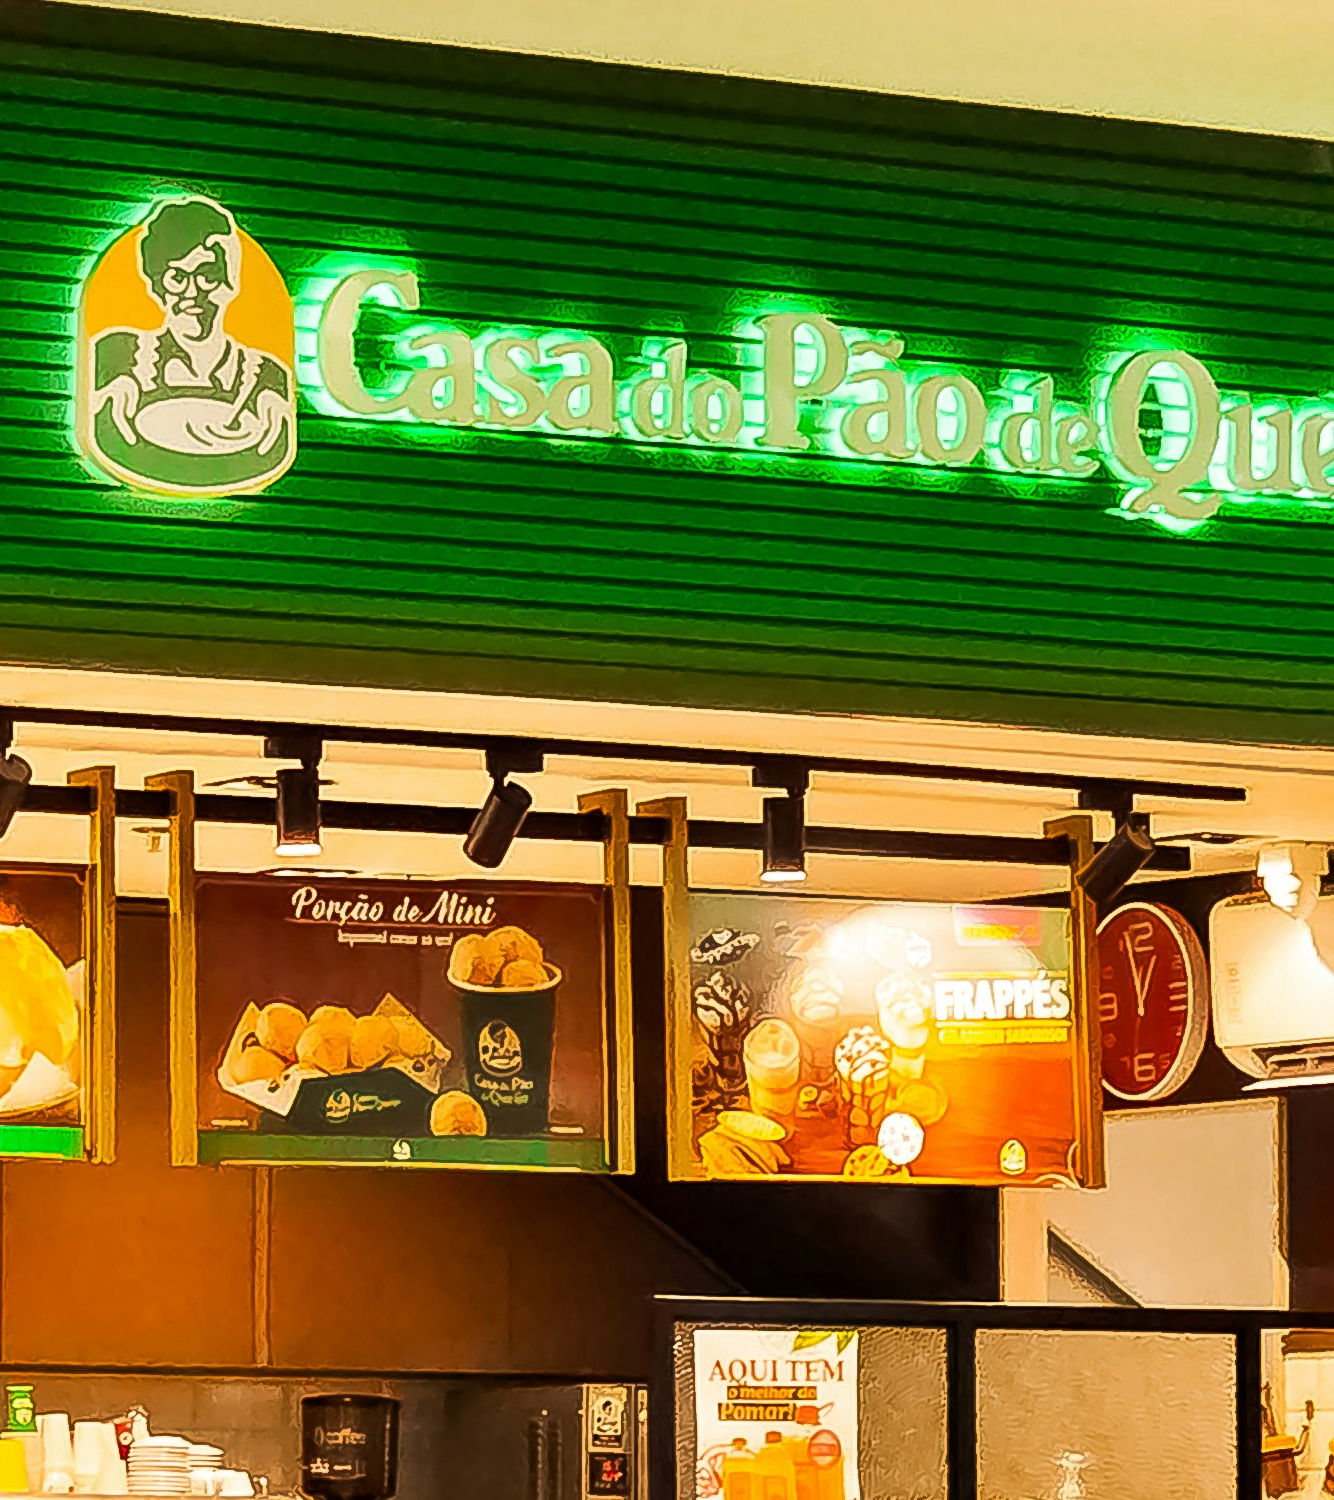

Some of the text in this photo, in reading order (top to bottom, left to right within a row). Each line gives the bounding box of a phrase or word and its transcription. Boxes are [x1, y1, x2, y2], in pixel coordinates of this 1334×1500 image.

[317, 269, 619, 433] Casa
[632, 339, 743, 442] do
[754, 312, 988, 463] Pão
[1001, 374, 1100, 474] de
[291, 886, 497, 926] Porção de Mini
[933, 969, 1070, 1021] FRAPPÉS
[708, 1358, 844, 1386] AQUI TEM
[728, 1388, 738, 1399] o
[739, 1387, 797, 1399] melhor
[720, 1402, 795, 1420] Pomar!
